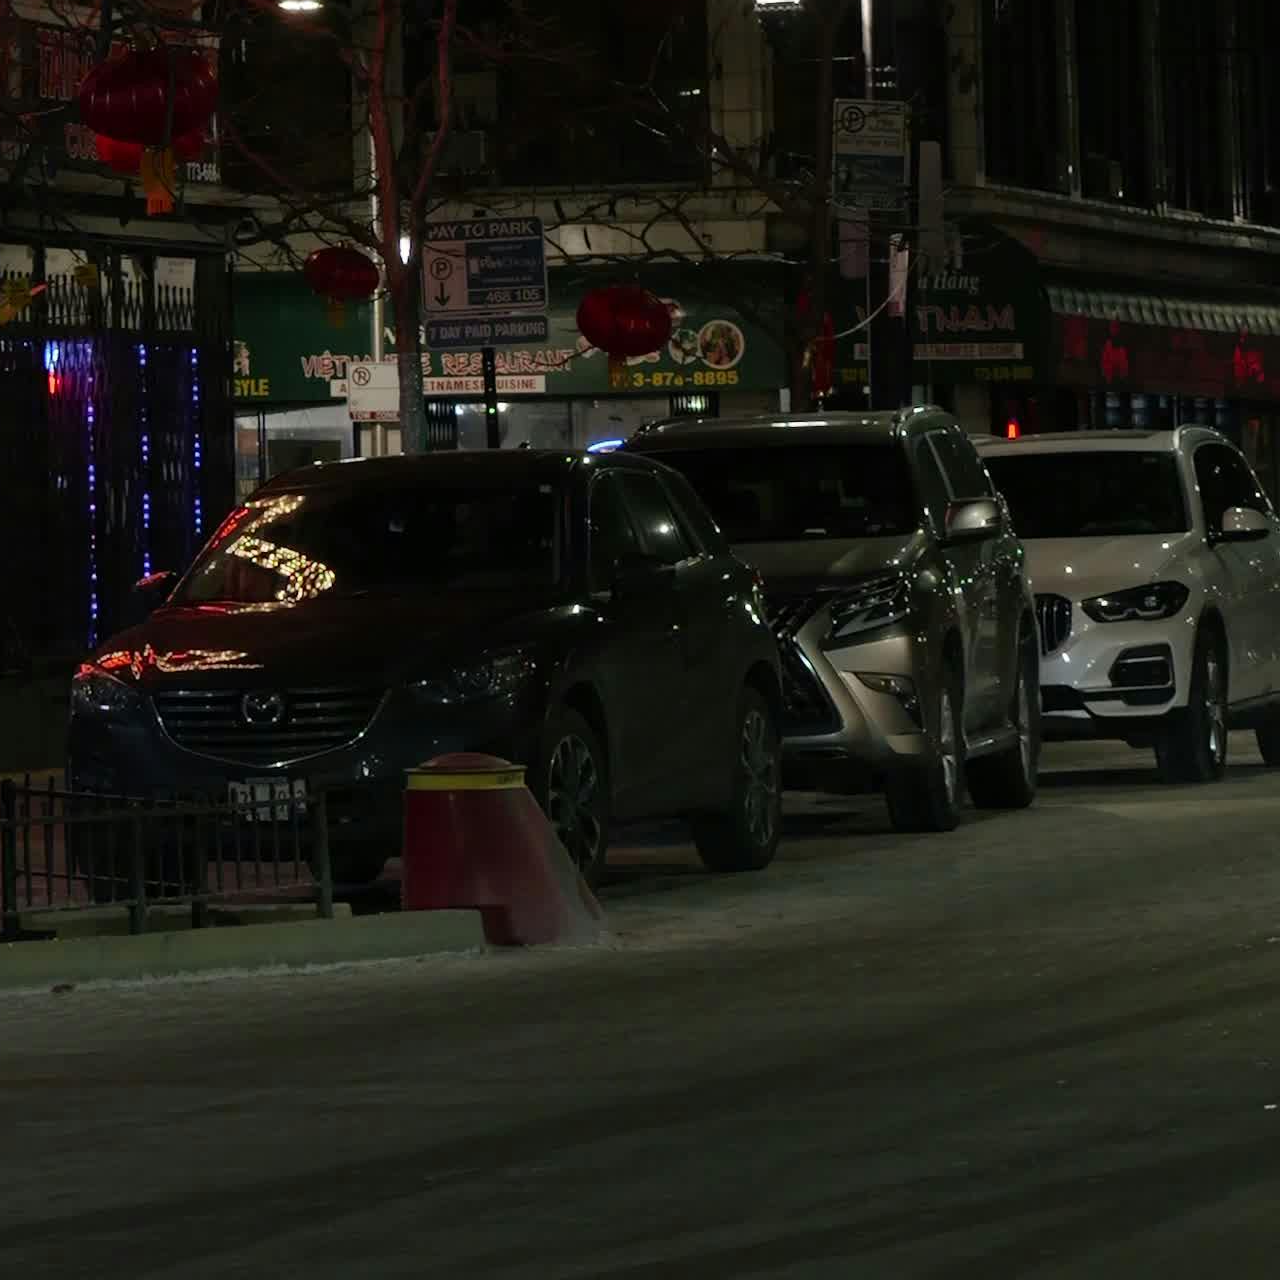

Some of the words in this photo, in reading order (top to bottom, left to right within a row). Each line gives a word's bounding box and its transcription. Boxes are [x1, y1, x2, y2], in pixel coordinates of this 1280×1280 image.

[428, 224, 457, 240] PAY
[463, 222, 485, 239] TO
[488, 218, 536, 238] PARK
[439, 324, 462, 339] DAY
[464, 323, 492, 338] PAID
[495, 320, 545, 337] PARKING
[440, 349, 577, 376] RESAURANT
[233, 378, 271, 397] GYLE
[422, 379, 486, 392] ETNAMES
[496, 378, 537, 390] UISINE
